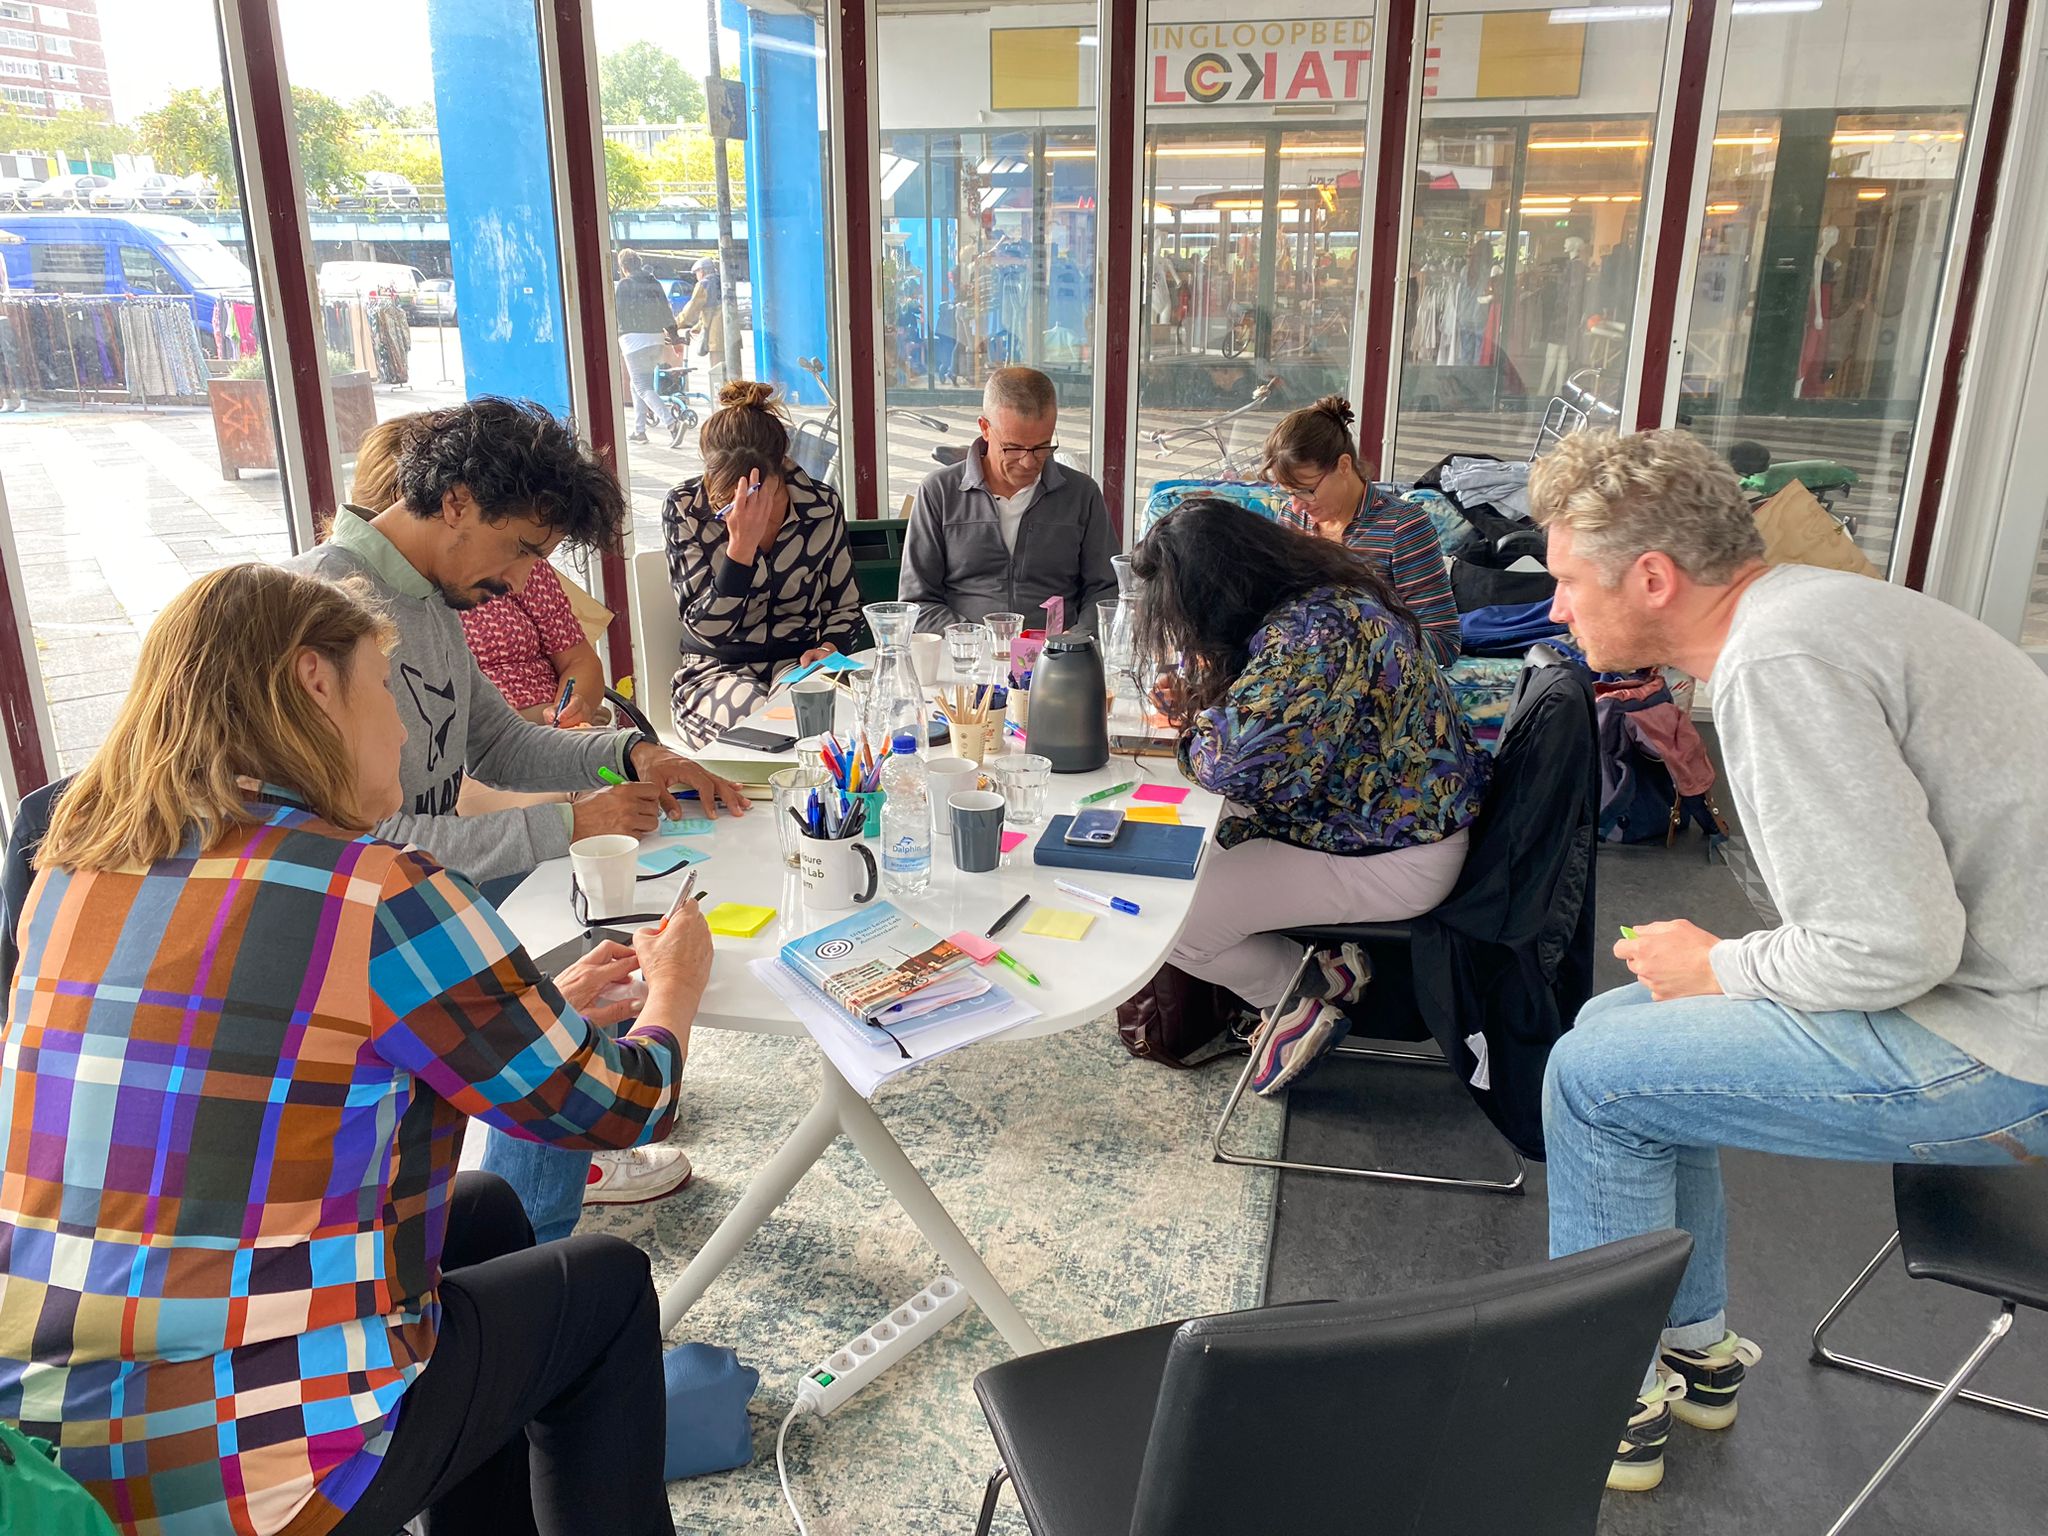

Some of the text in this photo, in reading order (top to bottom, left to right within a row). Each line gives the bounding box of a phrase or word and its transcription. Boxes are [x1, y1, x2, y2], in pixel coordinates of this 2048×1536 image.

[808, 867, 825, 879] Lab
[849, 926, 872, 938] Urban
[860, 924, 899, 945] Amsterdam
[862, 924, 888, 938] Tourism
